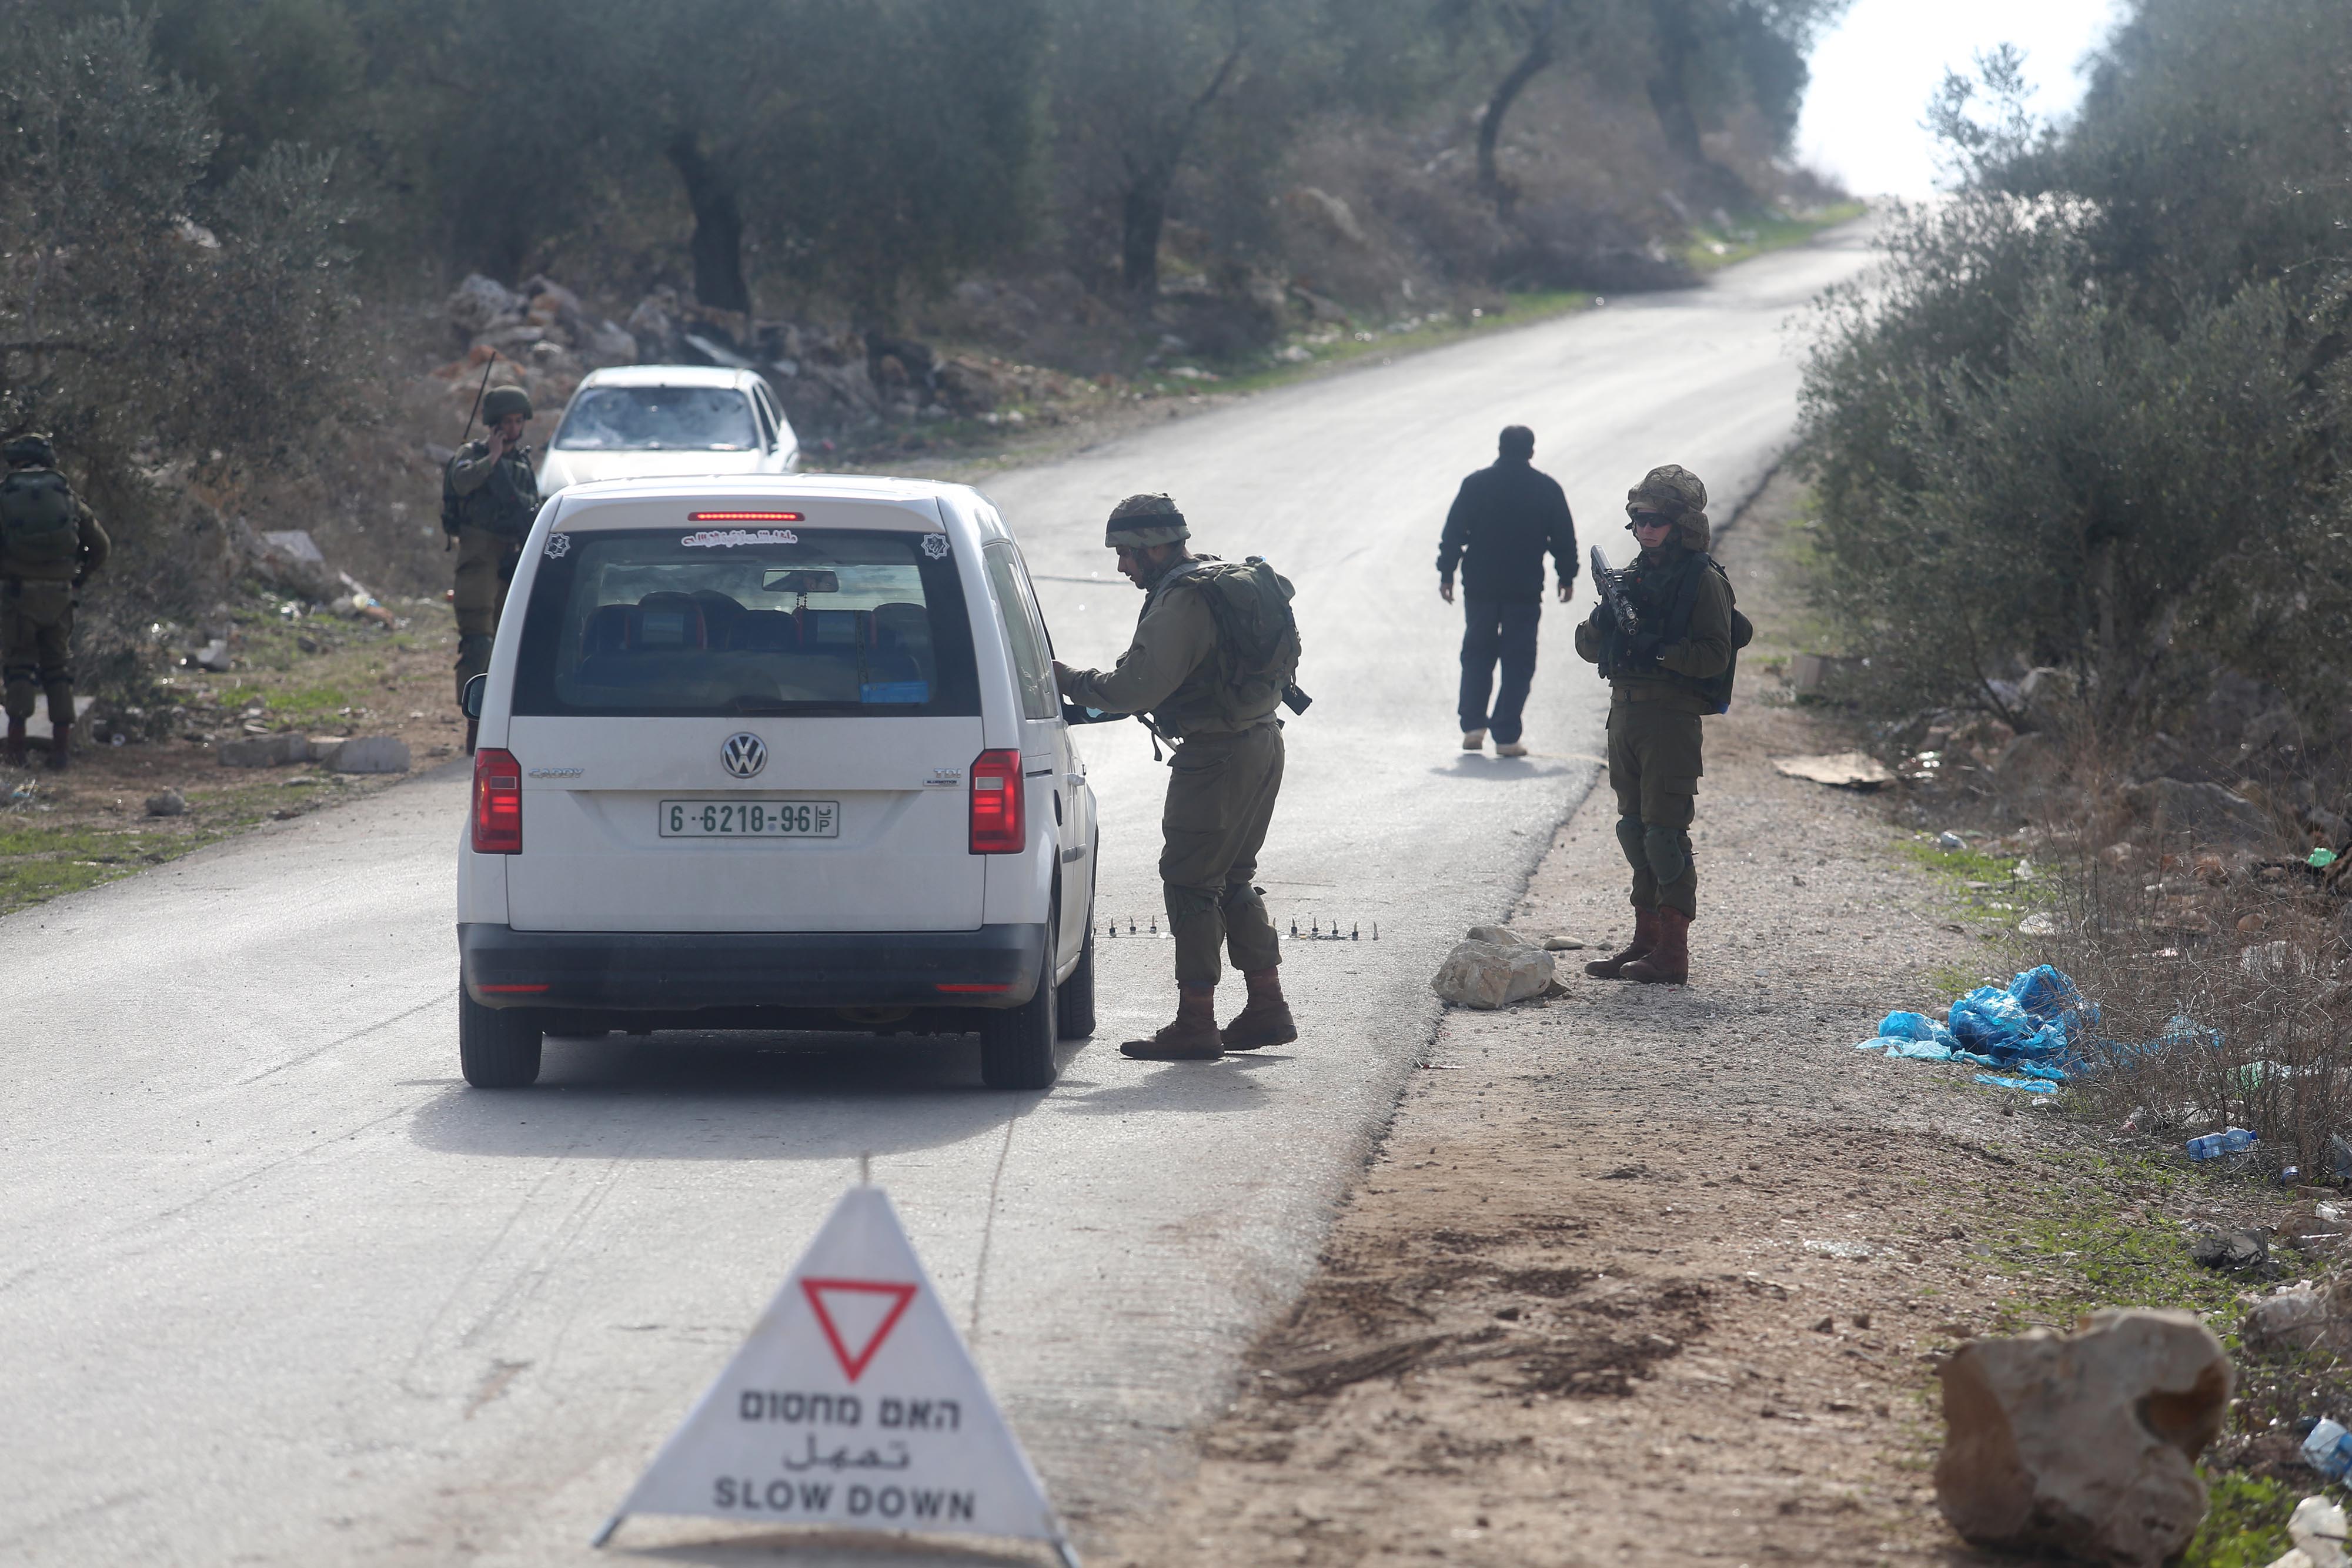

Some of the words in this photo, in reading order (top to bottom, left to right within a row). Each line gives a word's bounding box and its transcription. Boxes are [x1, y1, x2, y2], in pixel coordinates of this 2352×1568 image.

[528, 768, 585, 778] CADDY
[933, 768, 961, 778] TDI
[819, 820, 830, 833] P
[740, 1390, 863, 1426] מחסום
[783, 1433, 910, 1472] تمهل
[713, 1475, 833, 1512] SLOW
[847, 1485, 975, 1522] DOWN
